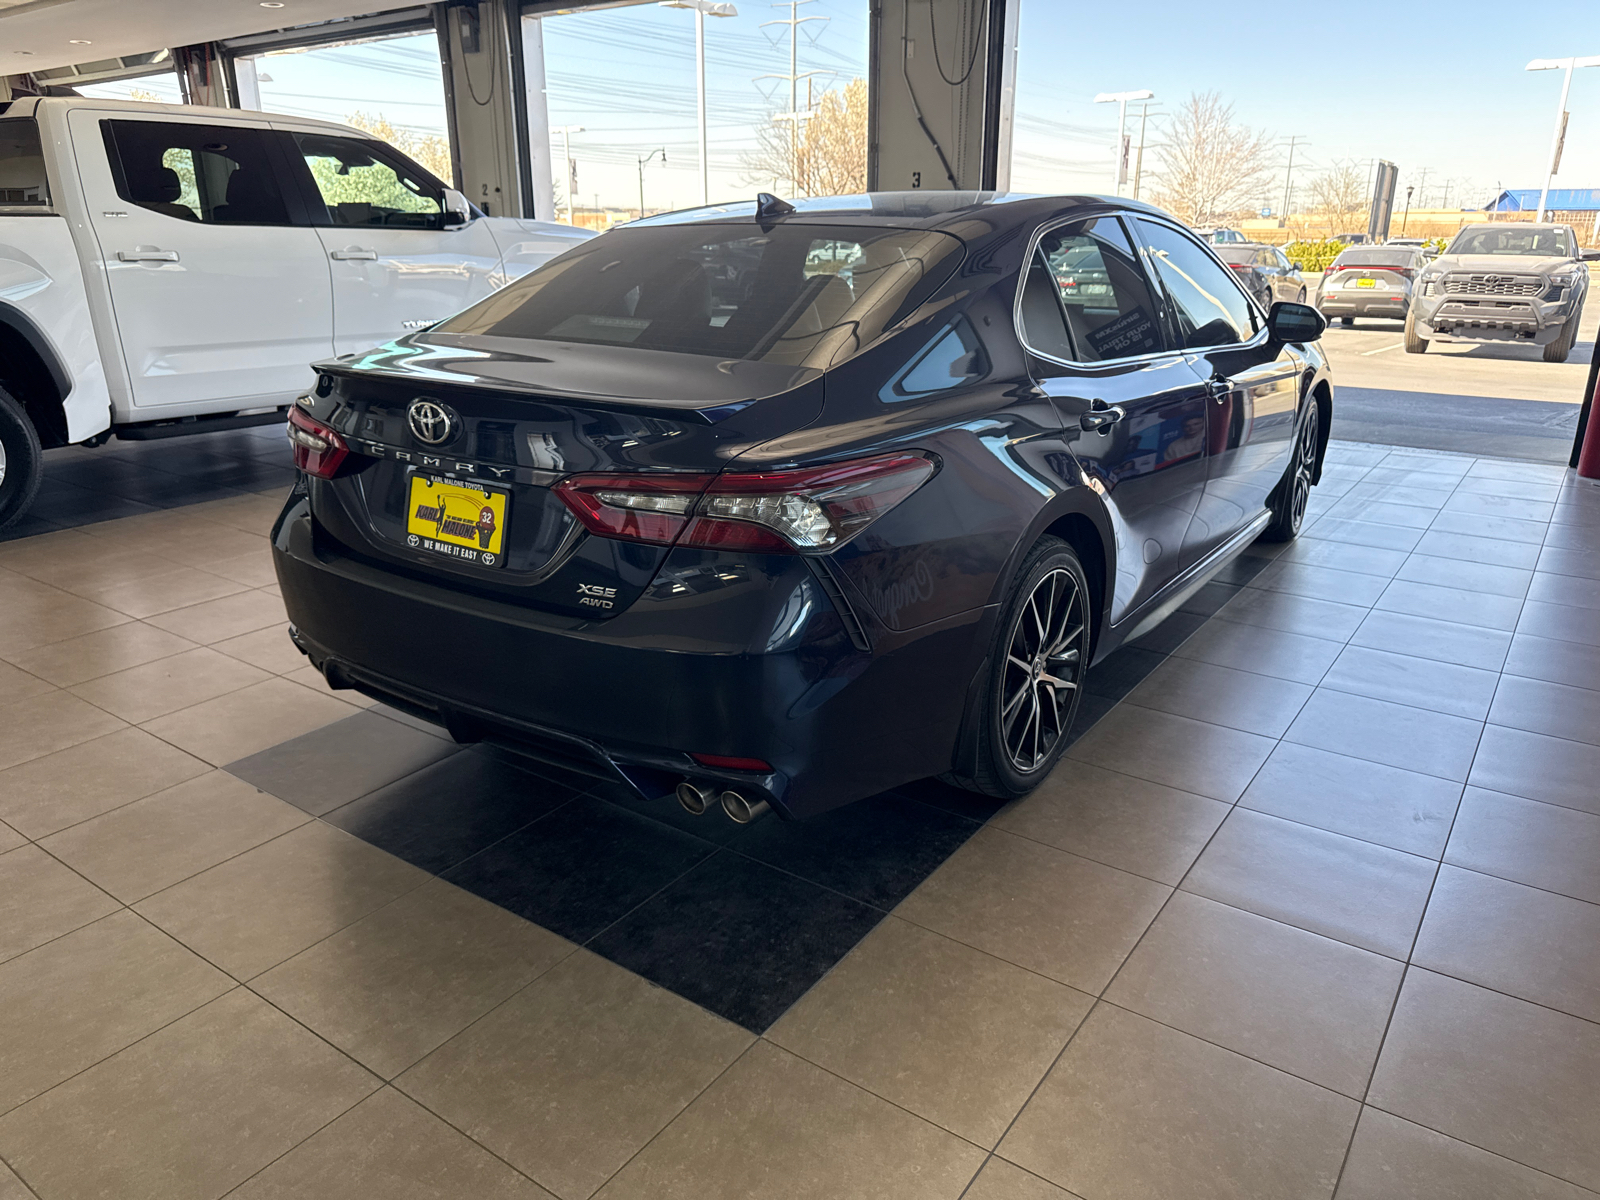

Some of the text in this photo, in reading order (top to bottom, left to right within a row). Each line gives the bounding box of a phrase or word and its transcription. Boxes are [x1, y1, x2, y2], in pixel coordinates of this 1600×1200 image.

[912, 171, 921, 189] 3
[481, 183, 489, 196] 2
[371, 445, 511, 477] CAMRY
[431, 475, 484, 492] KARL MALONE TOYOTA
[415, 504, 440, 522] KARL
[482, 511, 491, 524] 32
[441, 519, 477, 541] MALONE
[424, 539, 478, 560] WE MAKE IT EASY
[576, 583, 617, 598] XSE
[579, 597, 614, 609] AWD
